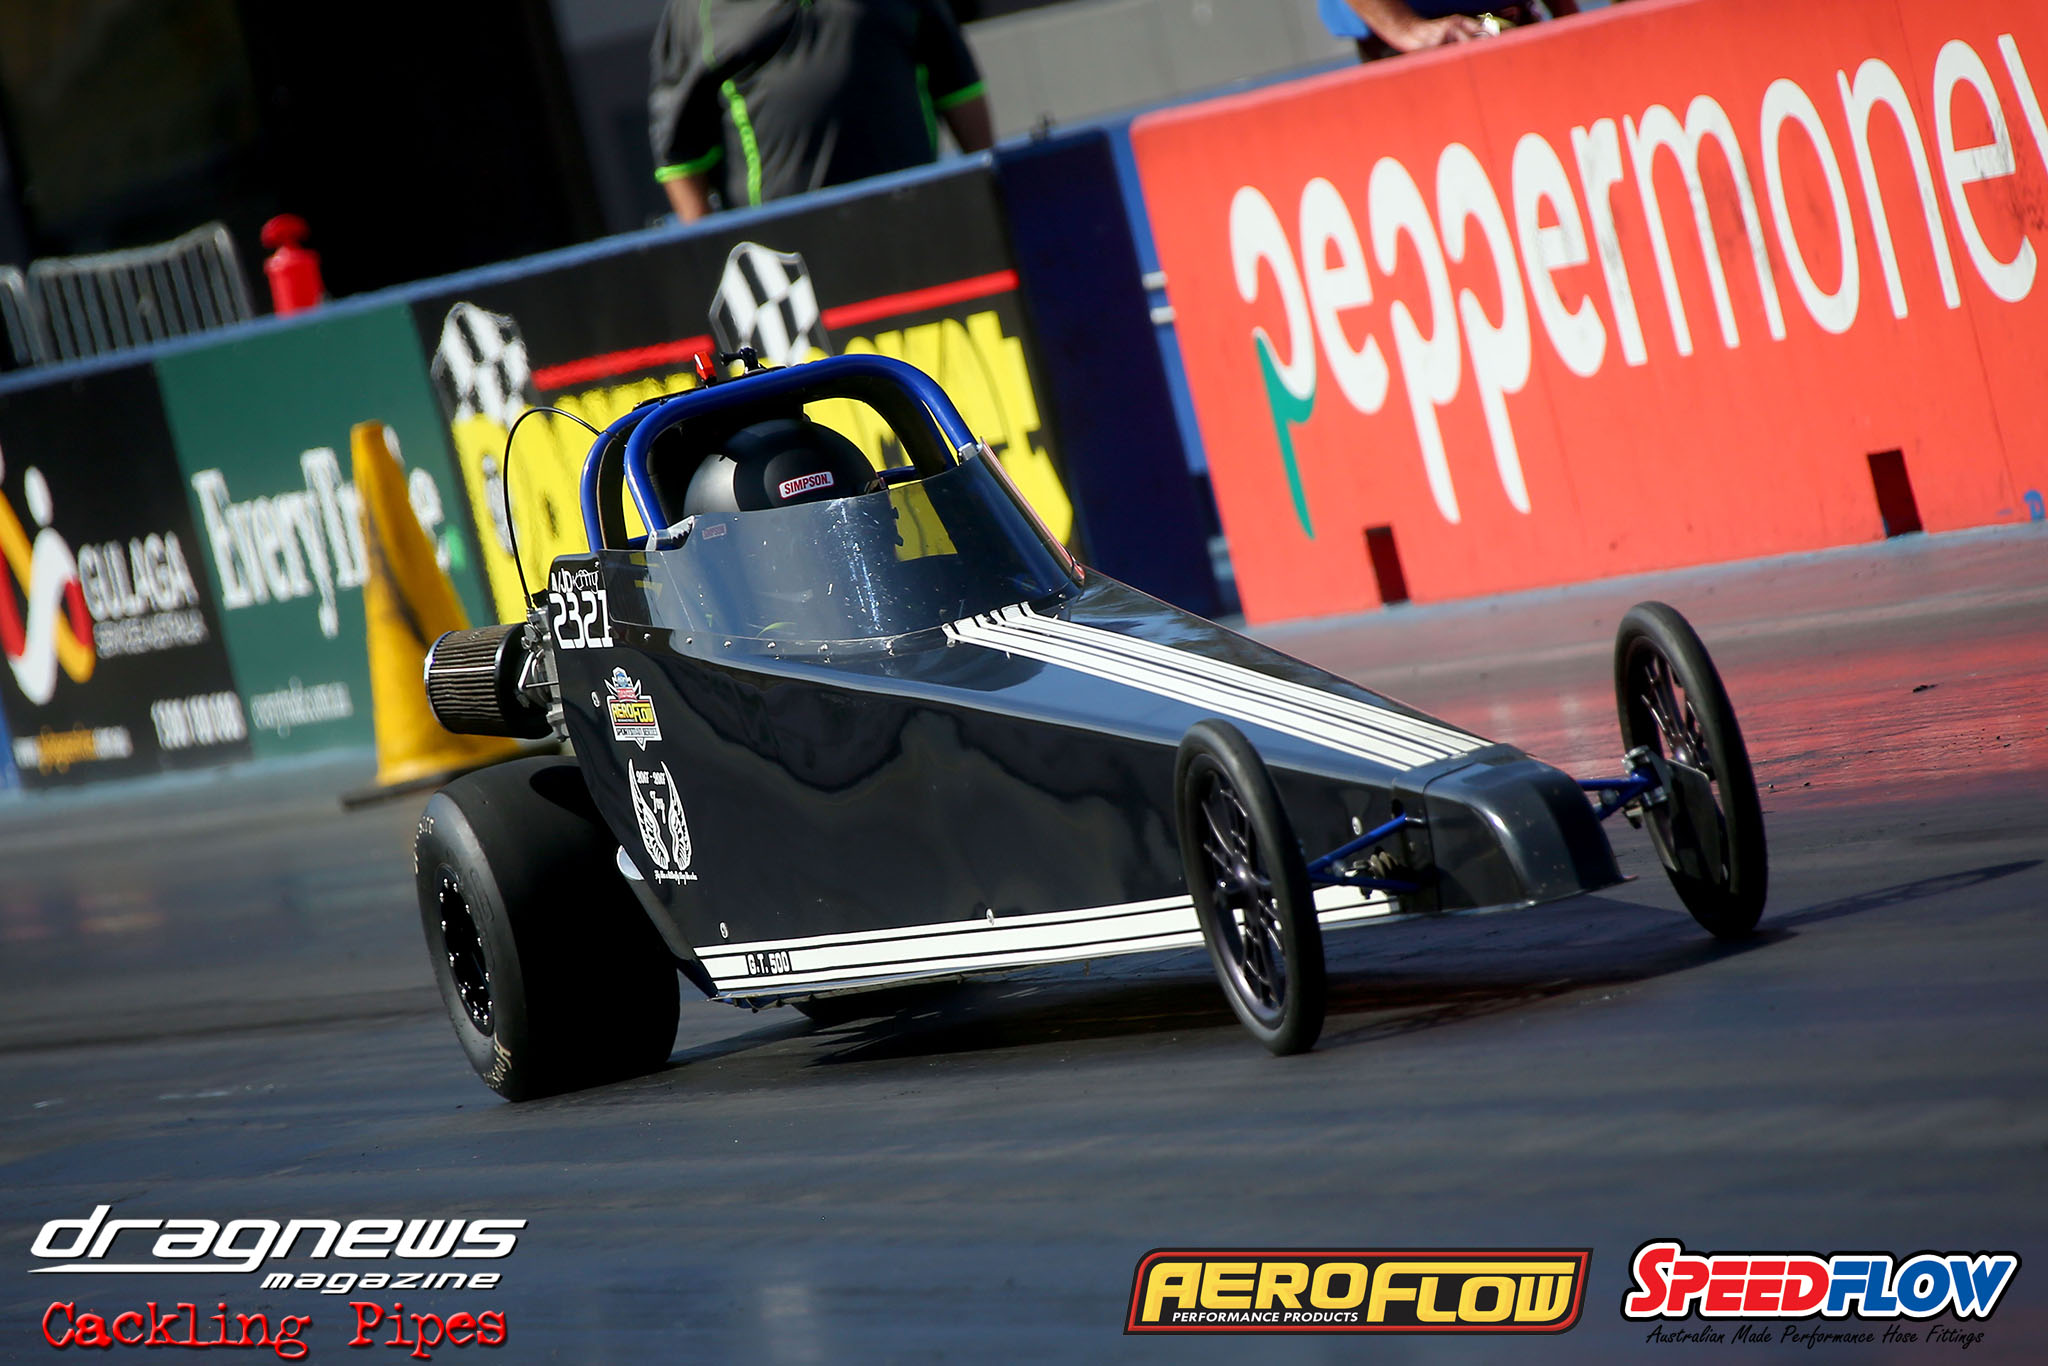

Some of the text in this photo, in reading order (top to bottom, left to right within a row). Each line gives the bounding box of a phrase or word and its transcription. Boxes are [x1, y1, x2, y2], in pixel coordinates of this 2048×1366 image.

[77, 531, 199, 621] GULAGA
[549, 590, 614, 649] 2321
[747, 951, 790, 975] G.T. 500
